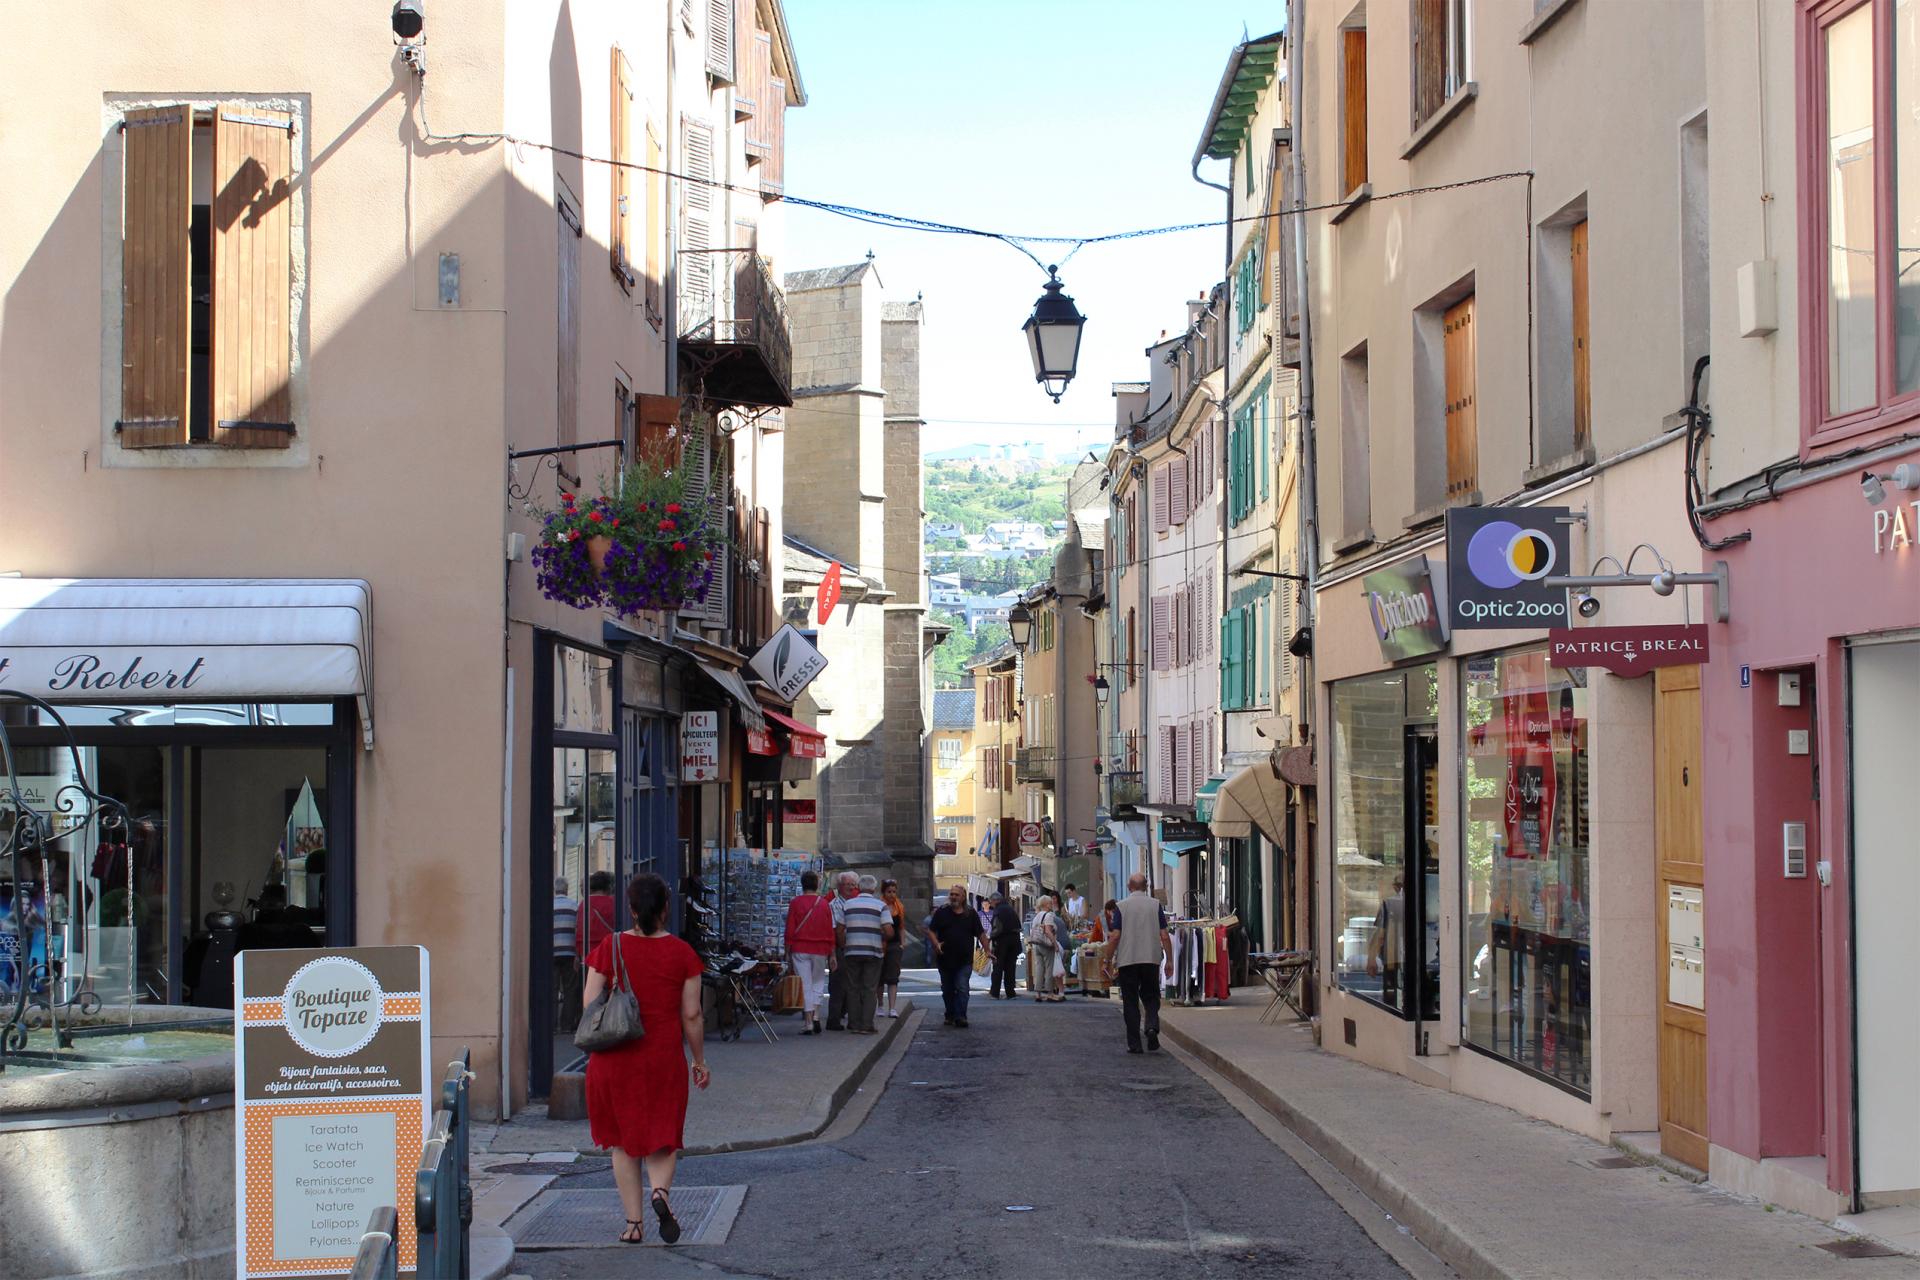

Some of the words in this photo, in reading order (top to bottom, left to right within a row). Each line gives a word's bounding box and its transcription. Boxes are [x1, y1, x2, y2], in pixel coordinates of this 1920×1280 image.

[823, 578, 835, 609] TABAC
[1458, 599, 1513, 622] Optic
[1516, 600, 1565, 616] 2000
[1555, 640, 1635, 654] PATRICE
[1642, 639, 1704, 651] BREAL
[48, 654, 205, 691] Robert
[780, 656, 820, 697] PRESSE
[690, 715, 708, 727] ICI
[682, 755, 717, 767] MIEL
[292, 988, 371, 1008] Boutique
[298, 1008, 368, 1034] Topaze
[279, 1066, 311, 1080] Bijoux
[310, 1065, 362, 1079] fantaisies,
[364, 1066, 388, 1075] sacs,
[264, 1081, 292, 1094] objets
[345, 1077, 402, 1089] accessoires.
[310, 1124, 358, 1135] Taratata
[305, 1143, 323, 1152] Ice
[326, 1141, 364, 1151] Watch
[313, 1159, 357, 1169] Scooter
[295, 1175, 374, 1187] Reminiscence
[304, 1188, 326, 1196] Bijoux
[316, 1202, 354, 1212] Nature
[311, 1219, 360, 1230] Lollipops
